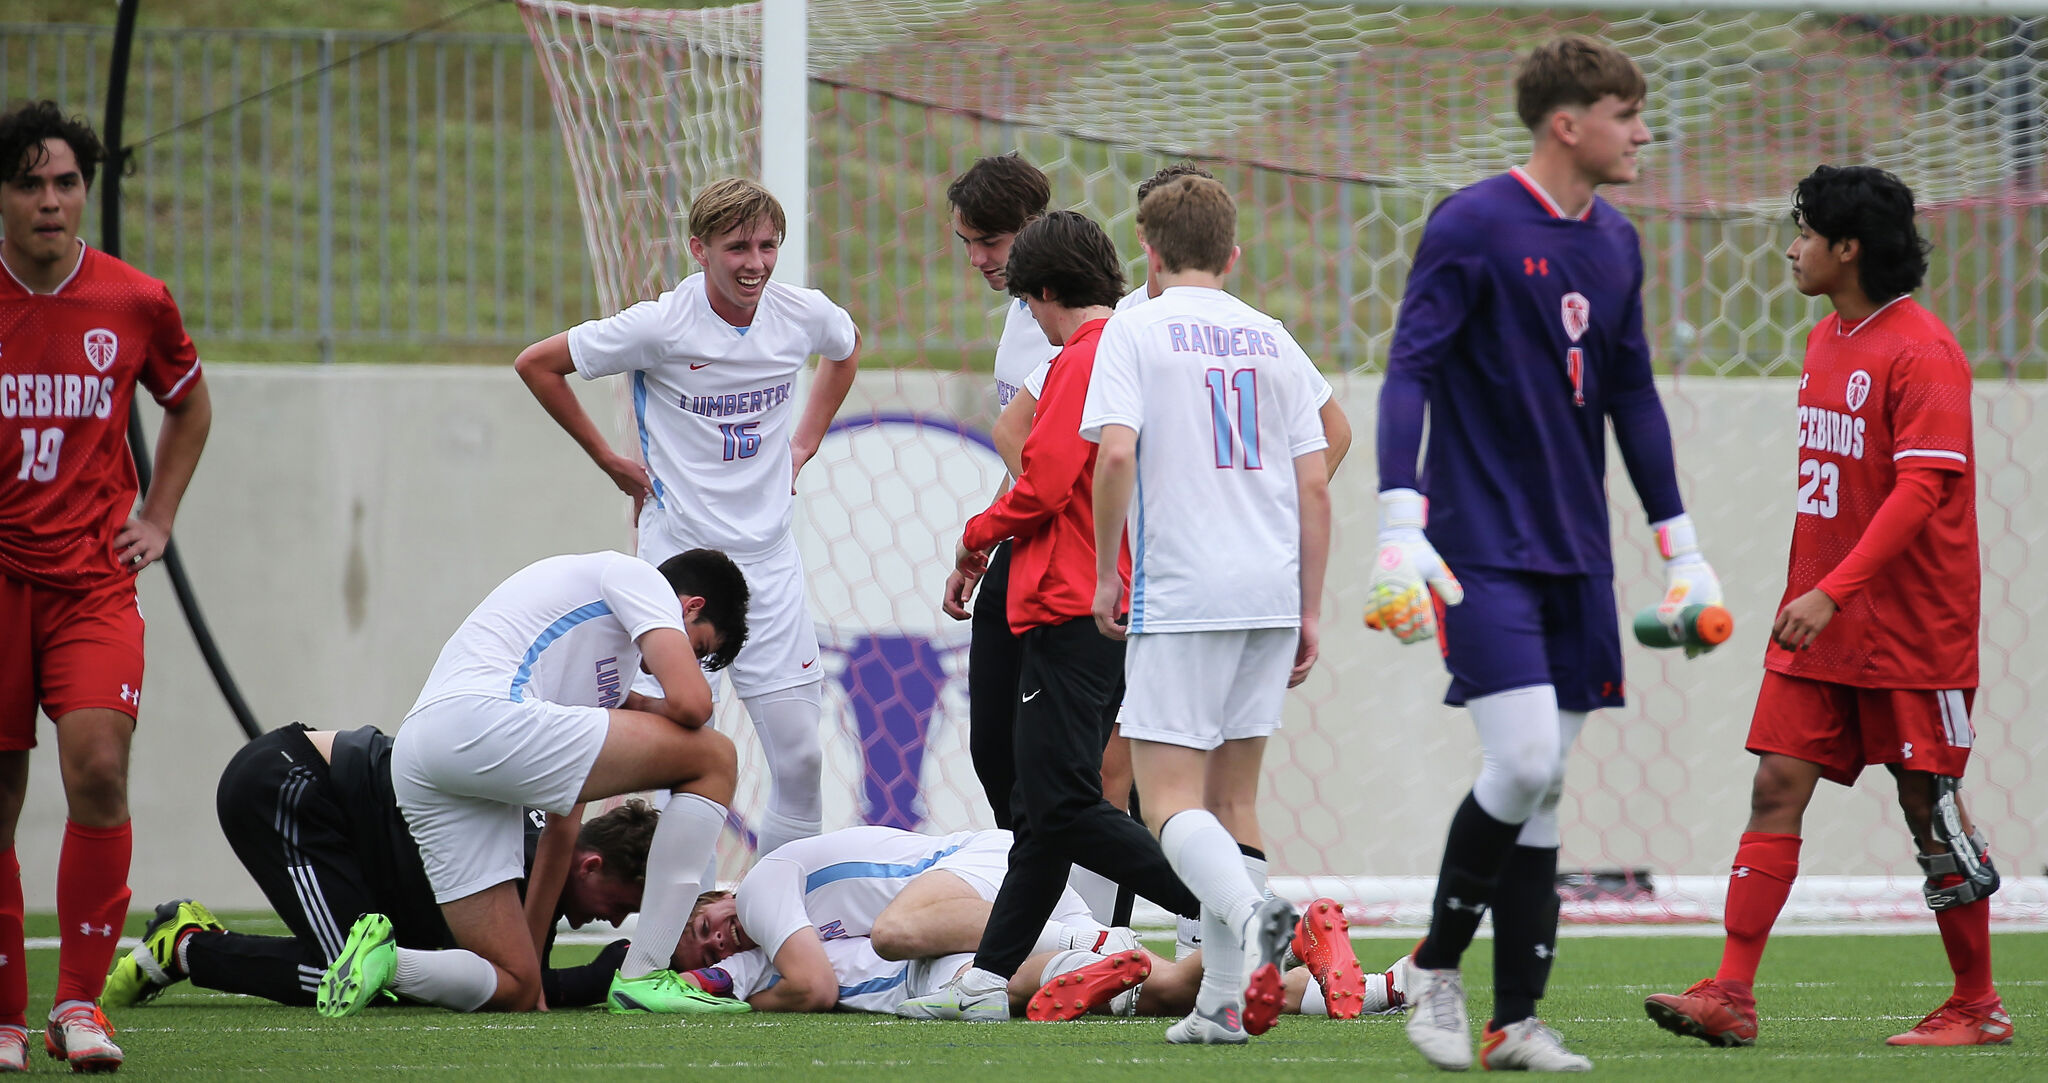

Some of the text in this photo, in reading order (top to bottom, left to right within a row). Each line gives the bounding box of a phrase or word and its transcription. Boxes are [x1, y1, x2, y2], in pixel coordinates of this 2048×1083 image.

[1168, 323, 1280, 358] RAIDERS
[0, 374, 114, 420] CEBIRDS
[1205, 367, 1263, 470] 11
[17, 427, 65, 482] 19
[718, 421, 762, 461] 16
[1797, 405, 1866, 460] CEBIRDS
[1797, 458, 1840, 519] 23
